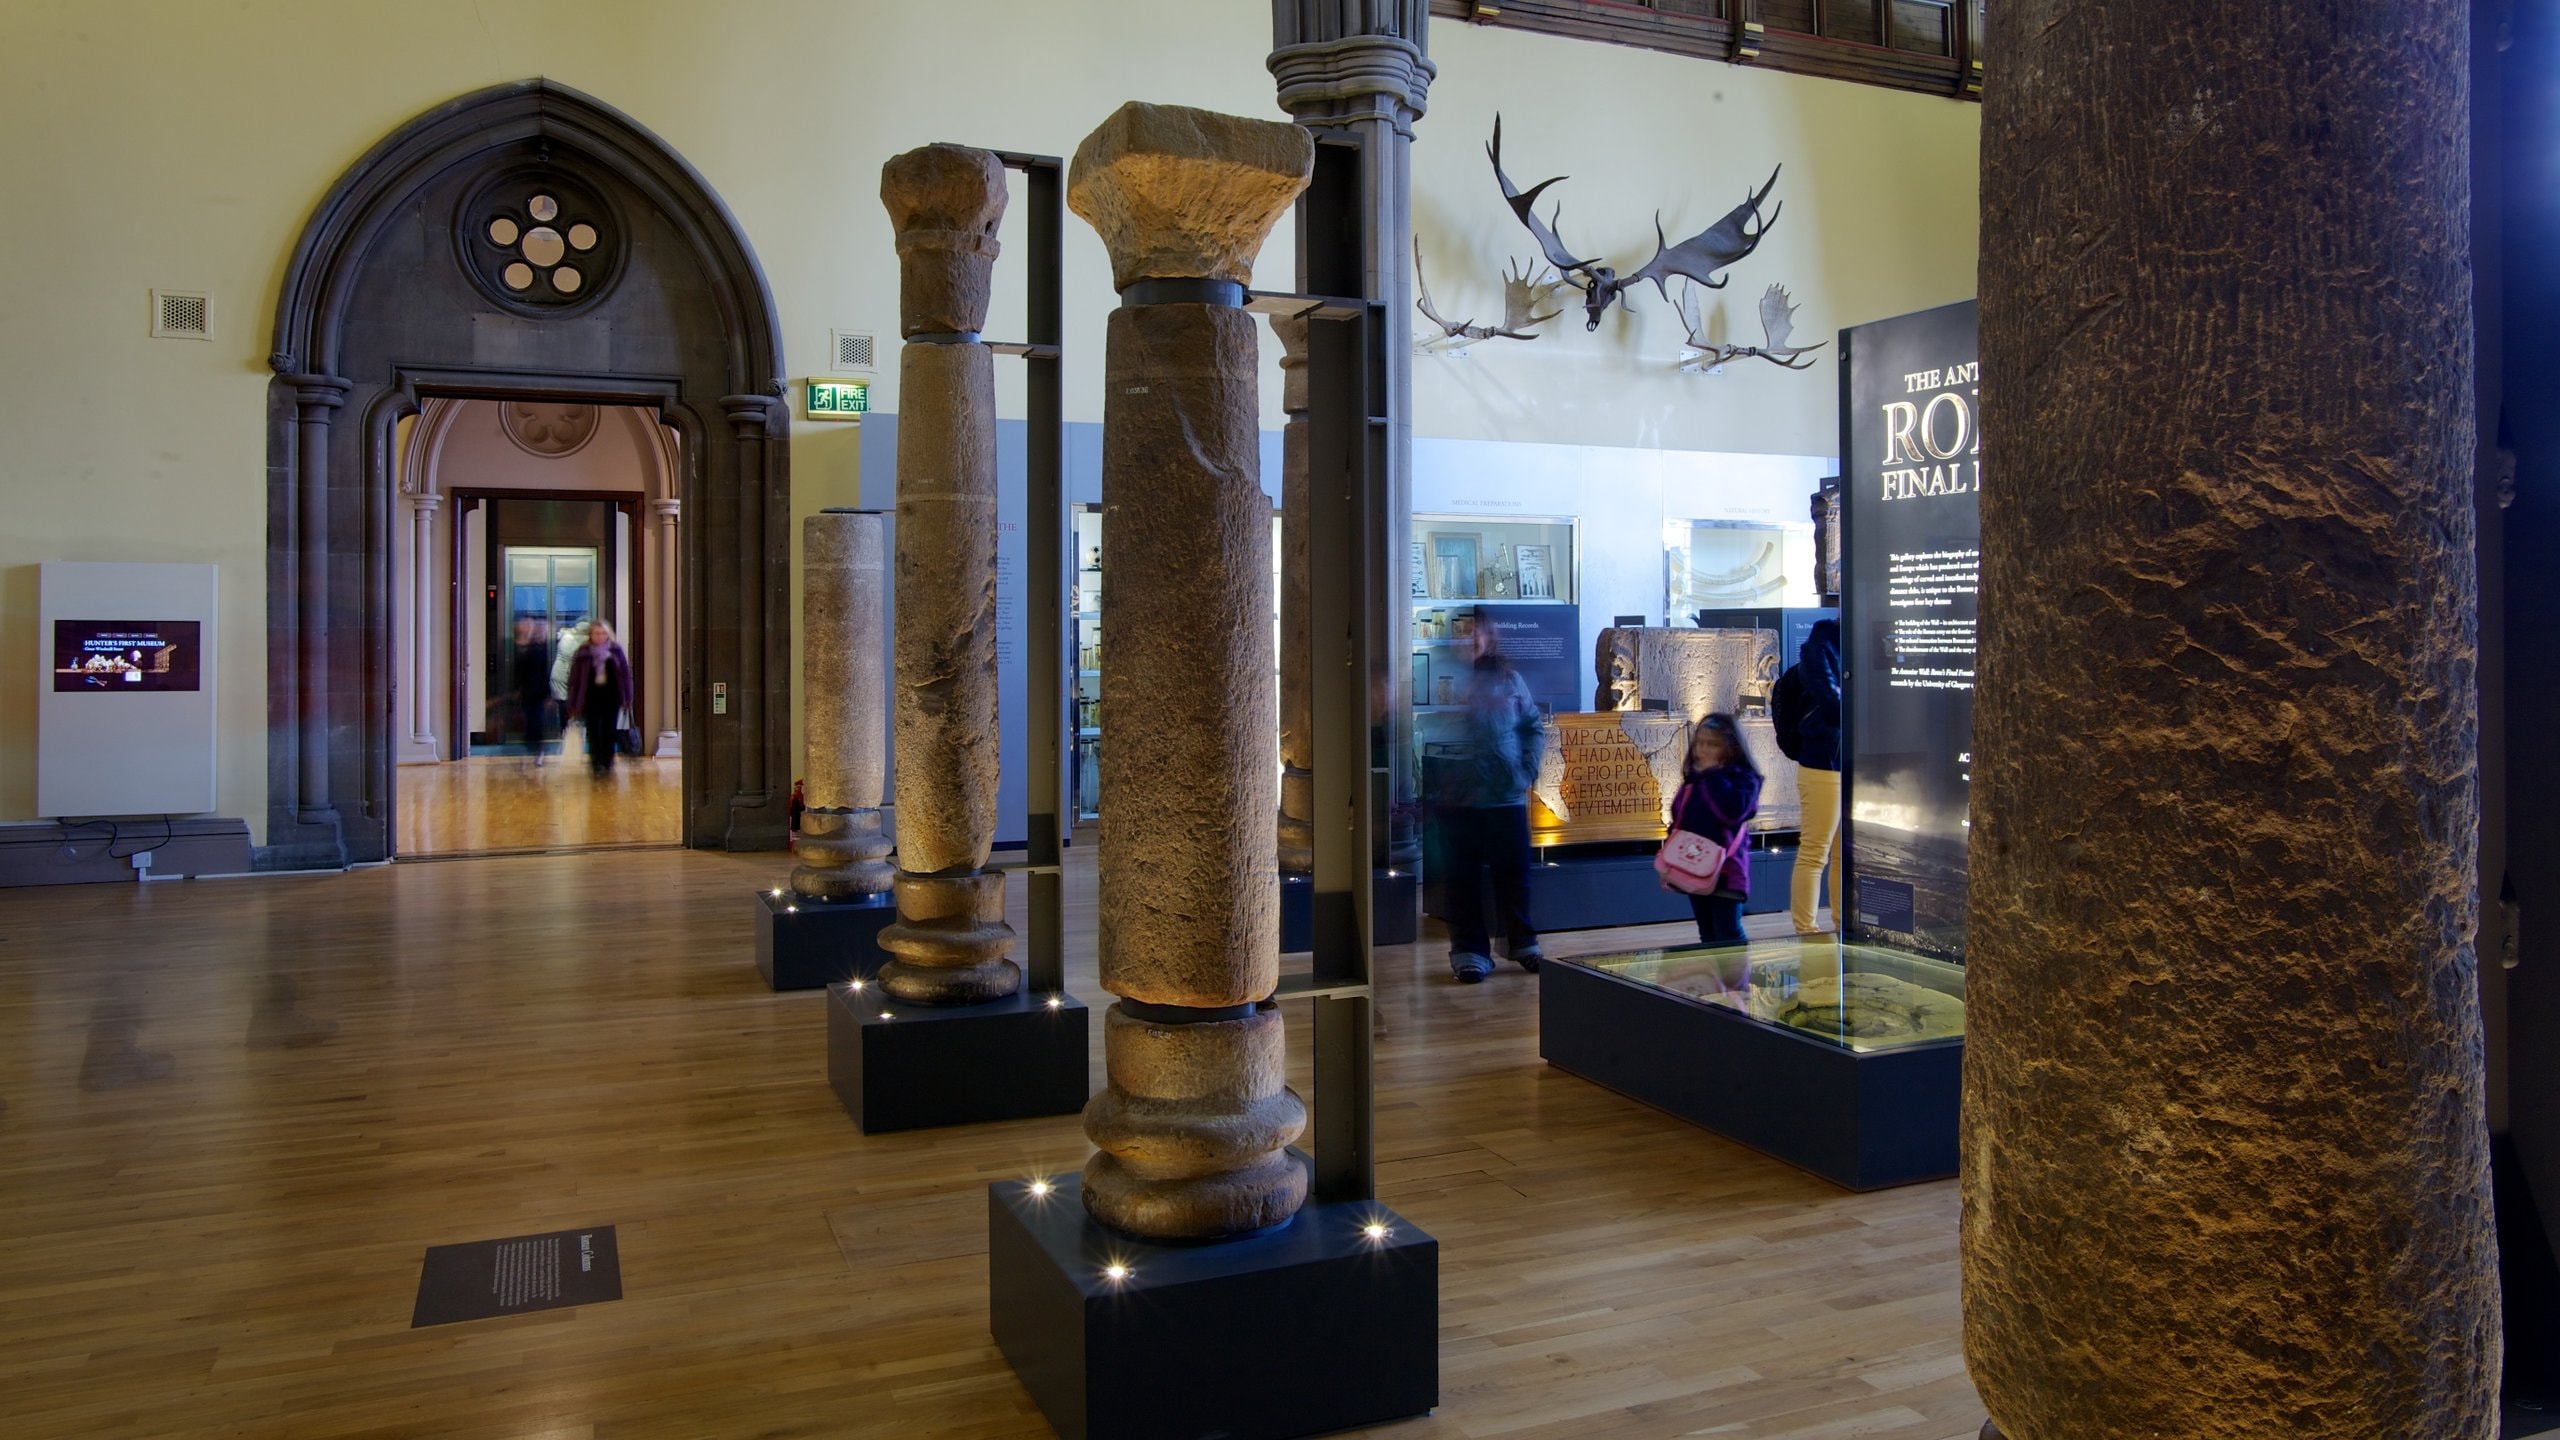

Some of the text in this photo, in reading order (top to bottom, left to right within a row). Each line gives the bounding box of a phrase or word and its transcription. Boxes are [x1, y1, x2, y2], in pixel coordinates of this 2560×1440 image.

[1904, 362, 1979, 393] THE ANT
[840, 388, 865, 400] FIRE
[841, 400, 866, 410] EXIT
[1882, 464, 1967, 500] FINAL
[998, 522, 1016, 530] THE
[1560, 728, 1590, 745] IMP
[1588, 765, 1610, 780] PIO
